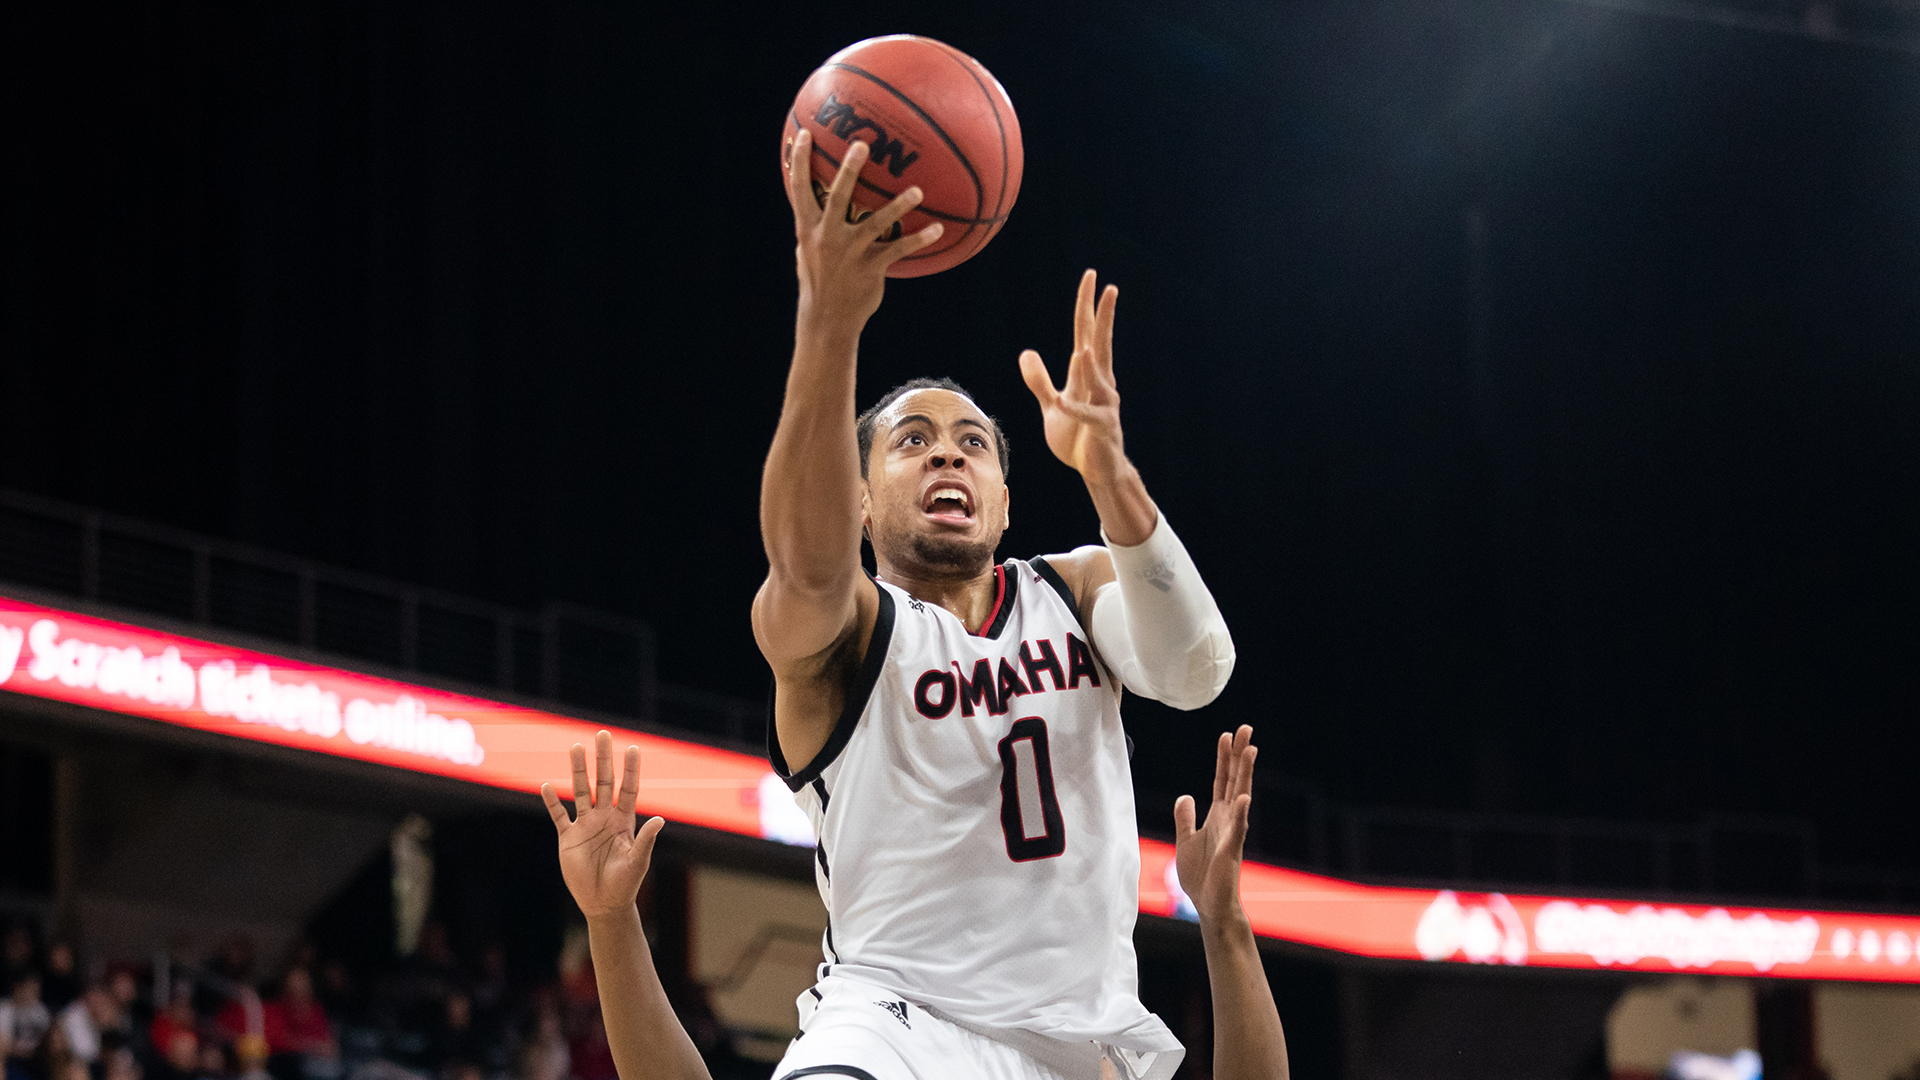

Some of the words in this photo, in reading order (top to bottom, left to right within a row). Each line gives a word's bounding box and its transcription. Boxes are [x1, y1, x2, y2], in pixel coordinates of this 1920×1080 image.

[815, 93, 919, 178] NCAA
[28, 619, 196, 709] Scratch
[914, 632, 1102, 720] OMAHA
[998, 716, 1066, 863] 0
[873, 1000, 912, 1031] adidas
